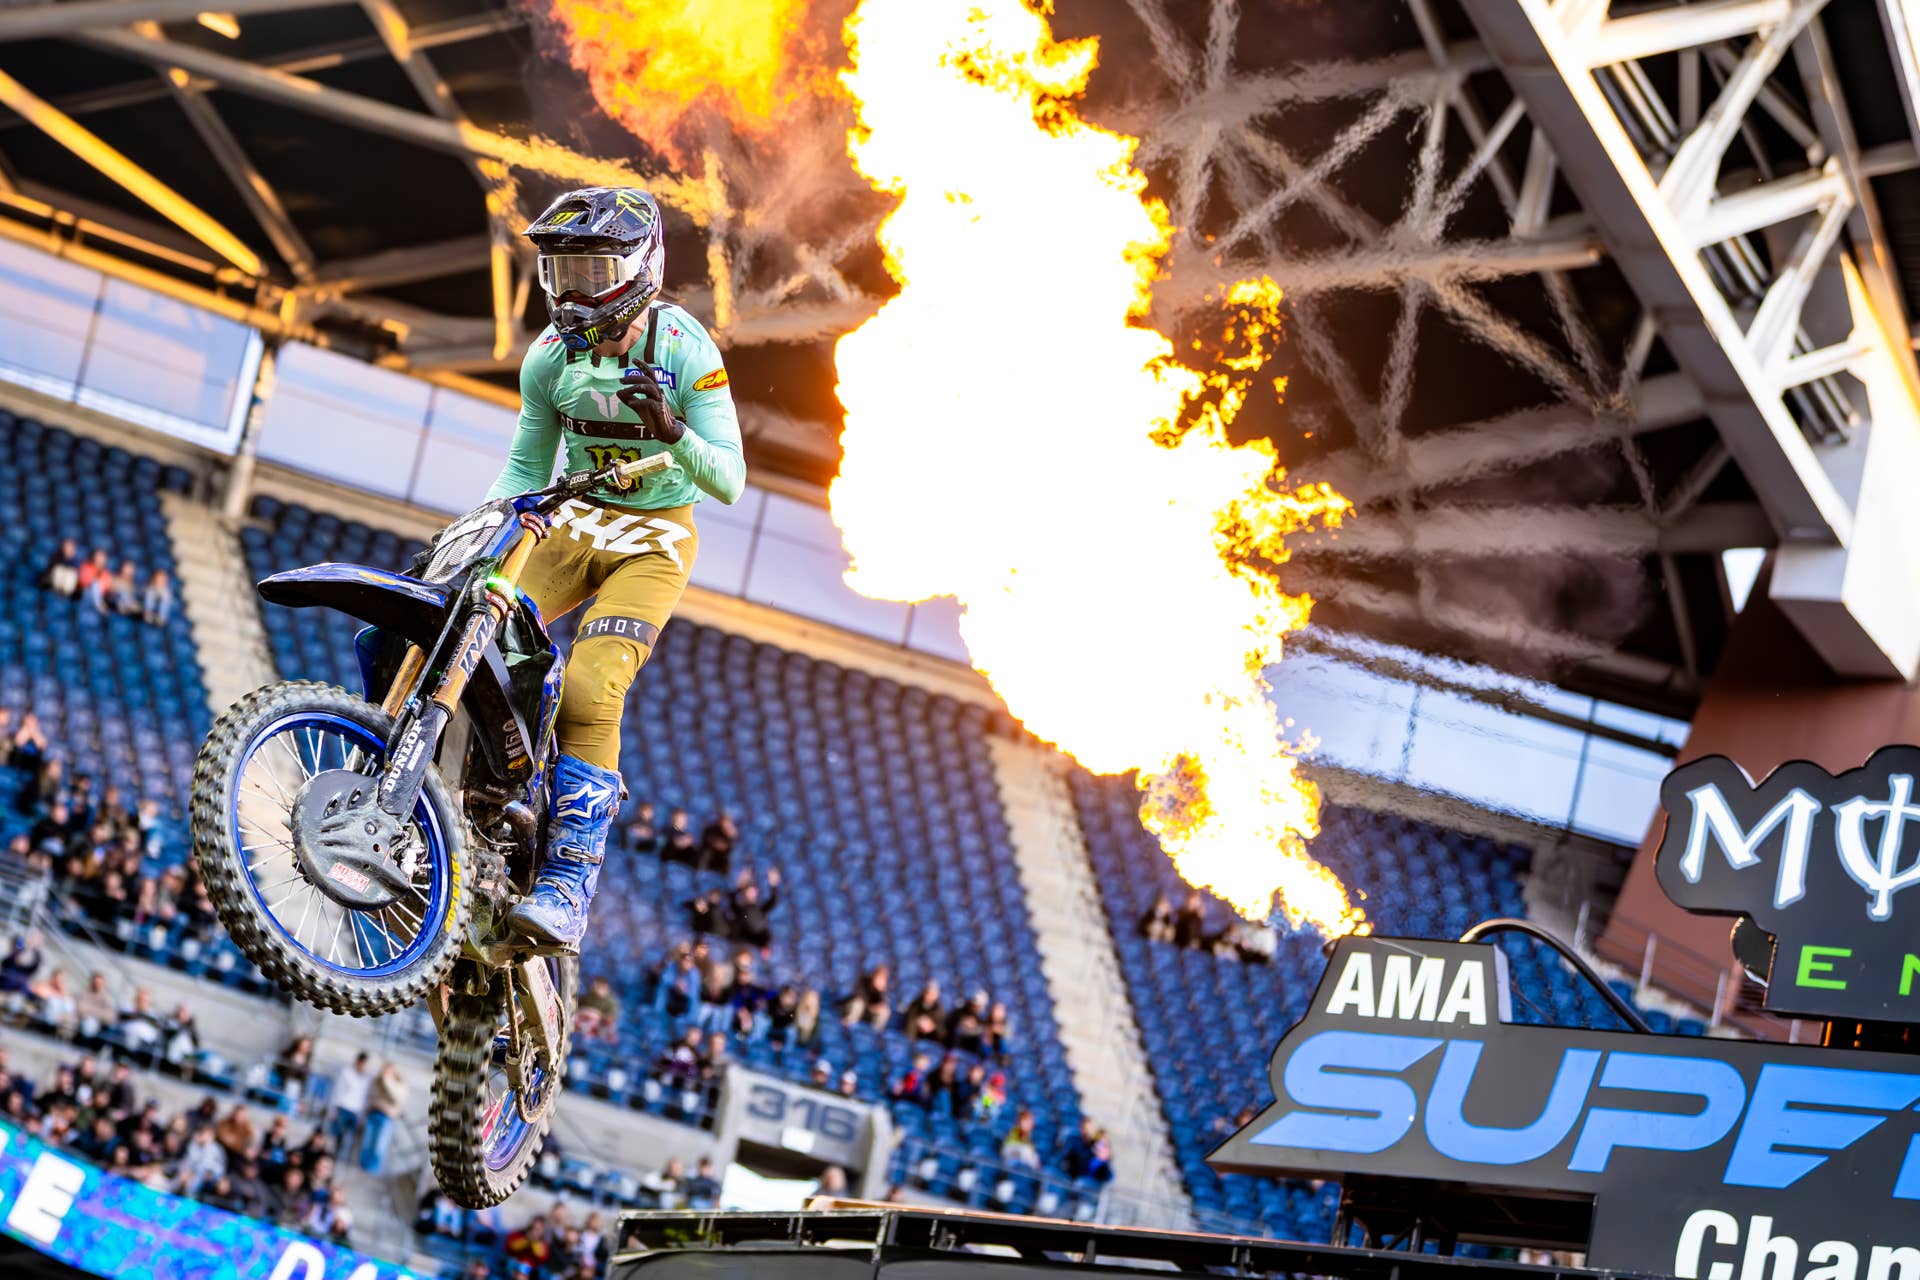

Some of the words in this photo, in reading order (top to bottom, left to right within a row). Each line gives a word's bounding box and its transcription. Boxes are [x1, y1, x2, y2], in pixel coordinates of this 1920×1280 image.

[586, 618, 643, 638] THOR
[383, 719, 422, 793] DUNLOP
[1325, 951, 1488, 1026] AMA
[747, 1083, 859, 1142] 316
[1249, 1030, 1920, 1199] SUPE
